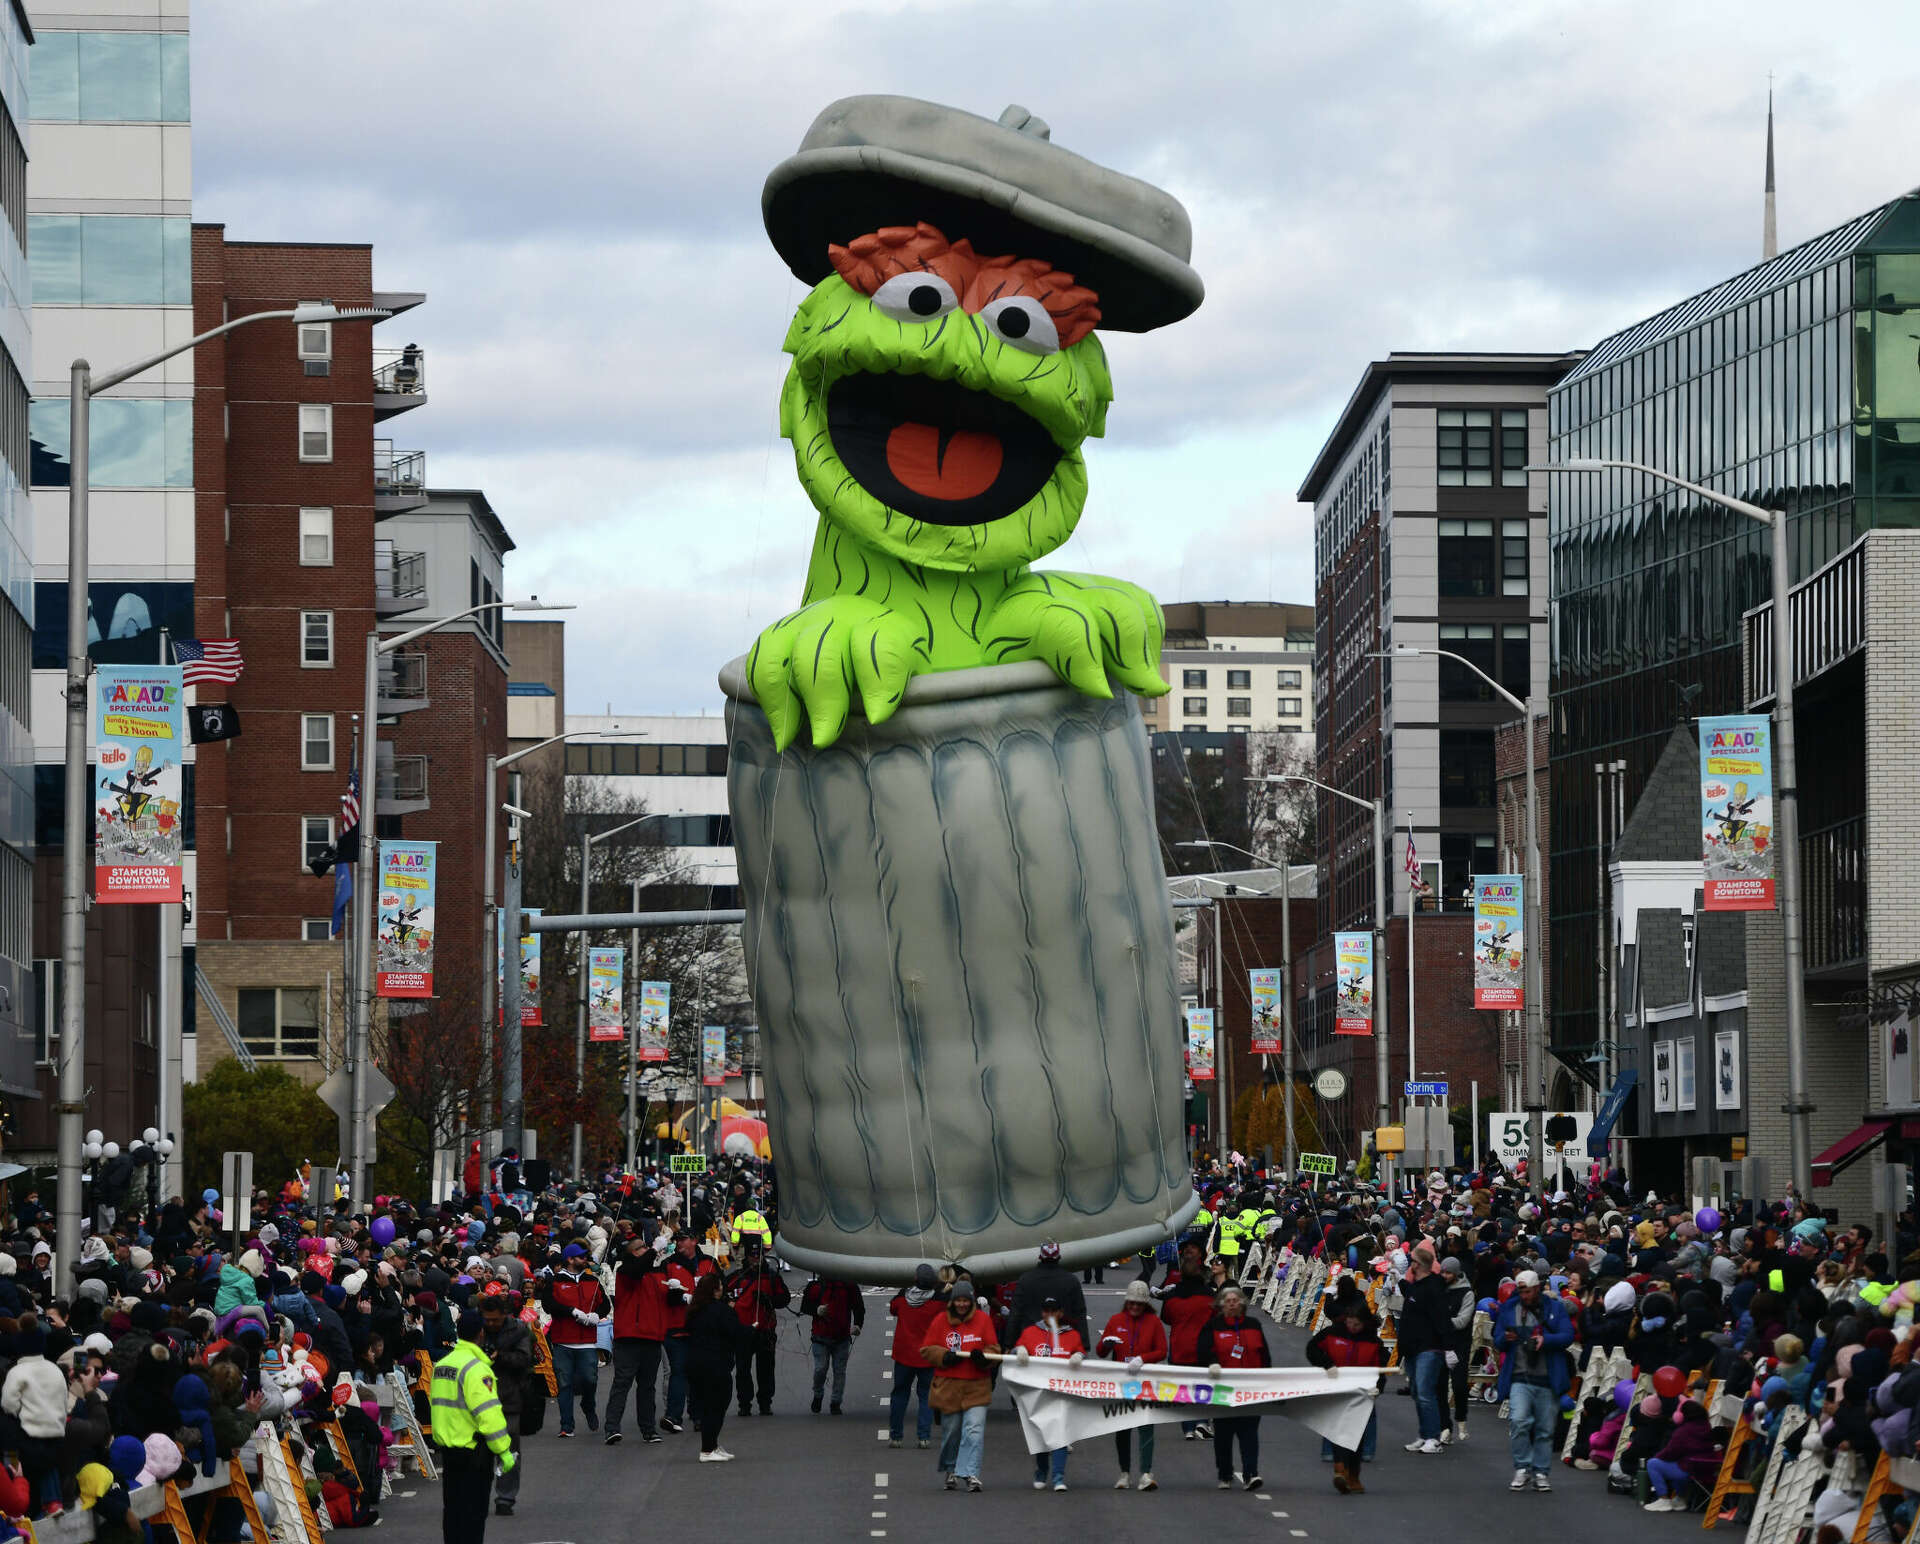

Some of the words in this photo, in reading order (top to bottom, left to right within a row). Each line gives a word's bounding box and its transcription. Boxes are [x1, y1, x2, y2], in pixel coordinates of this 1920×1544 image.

[102, 684, 178, 705] PARADE
[109, 705, 169, 713] SPECTACULAR
[119, 725, 129, 735] 12
[131, 727, 159, 737] Noon
[1704, 731, 1765, 748] PARADE
[384, 853, 433, 867] PARADE
[112, 867, 166, 876] STAMFORD
[108, 876, 170, 885] DOWNTOWN
[1714, 888, 1765, 896] DOWNTOWN
[1407, 1082, 1435, 1095] Spring
[1546, 1148, 1582, 1157] STEET
[674, 1156, 703, 1164] CROSS
[1303, 1154, 1334, 1165] CROSS
[1302, 1162, 1333, 1173] WALK
[434, 1367, 457, 1381] POLICE
[1048, 1378, 1116, 1390] STAMFORD
[1121, 1380, 1234, 1406] PARADE
[1102, 1400, 1136, 1418] WIN
